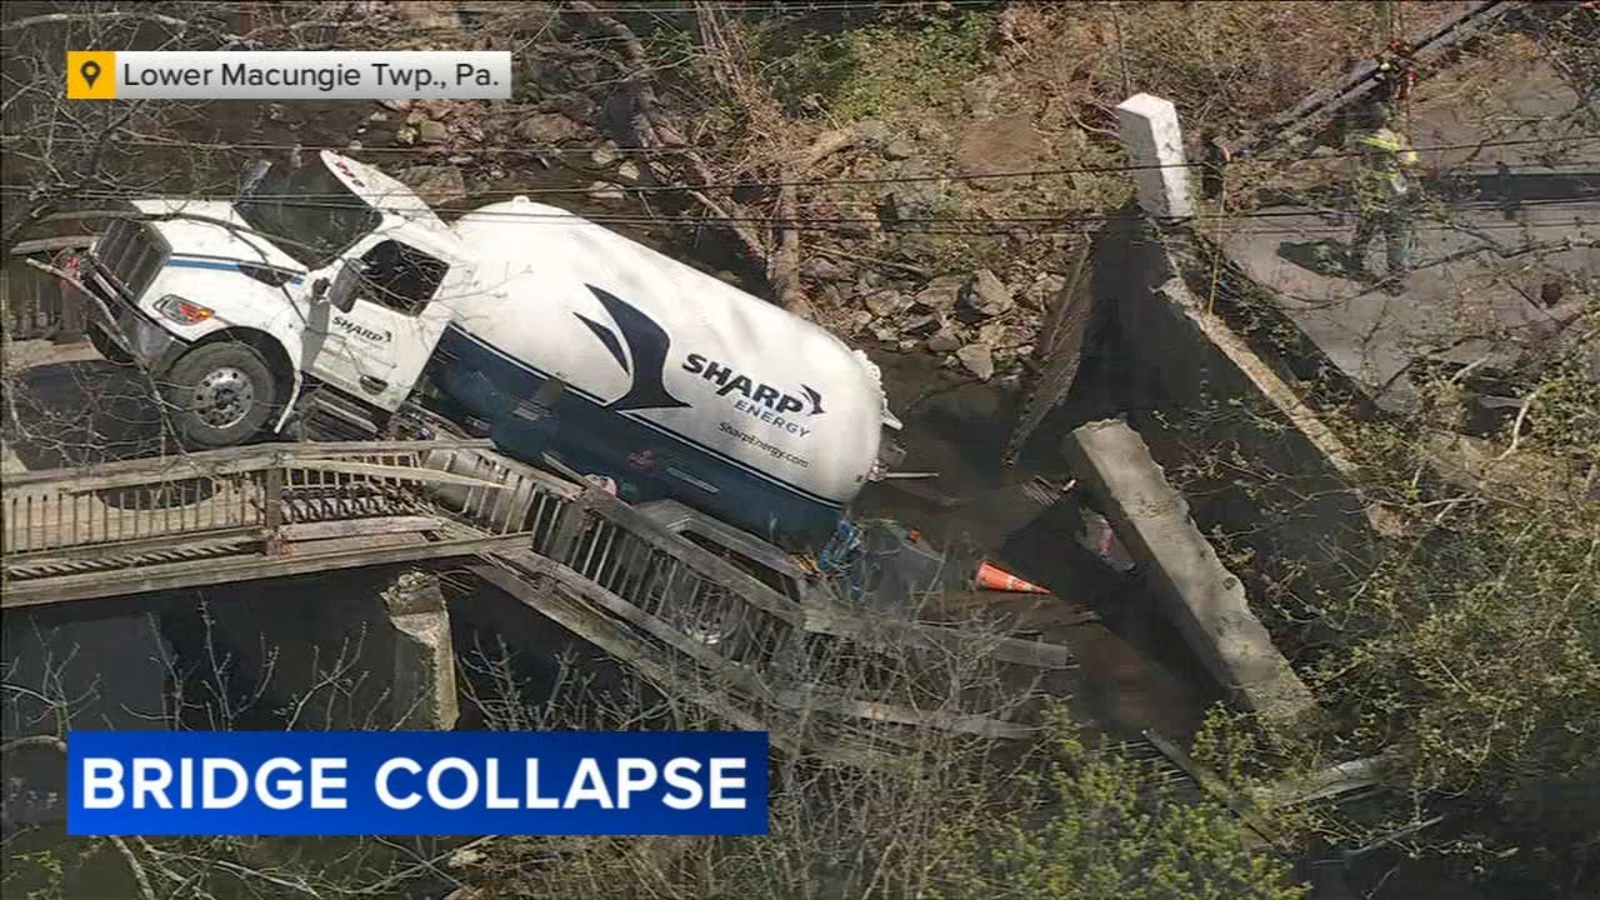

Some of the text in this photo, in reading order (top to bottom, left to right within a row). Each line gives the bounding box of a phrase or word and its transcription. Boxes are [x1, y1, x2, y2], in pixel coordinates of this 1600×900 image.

[332, 316, 384, 341] SHARP
[682, 353, 803, 414] SHARP
[734, 399, 811, 438] ENERGY
[718, 421, 811, 468] SharpEnergy.com
